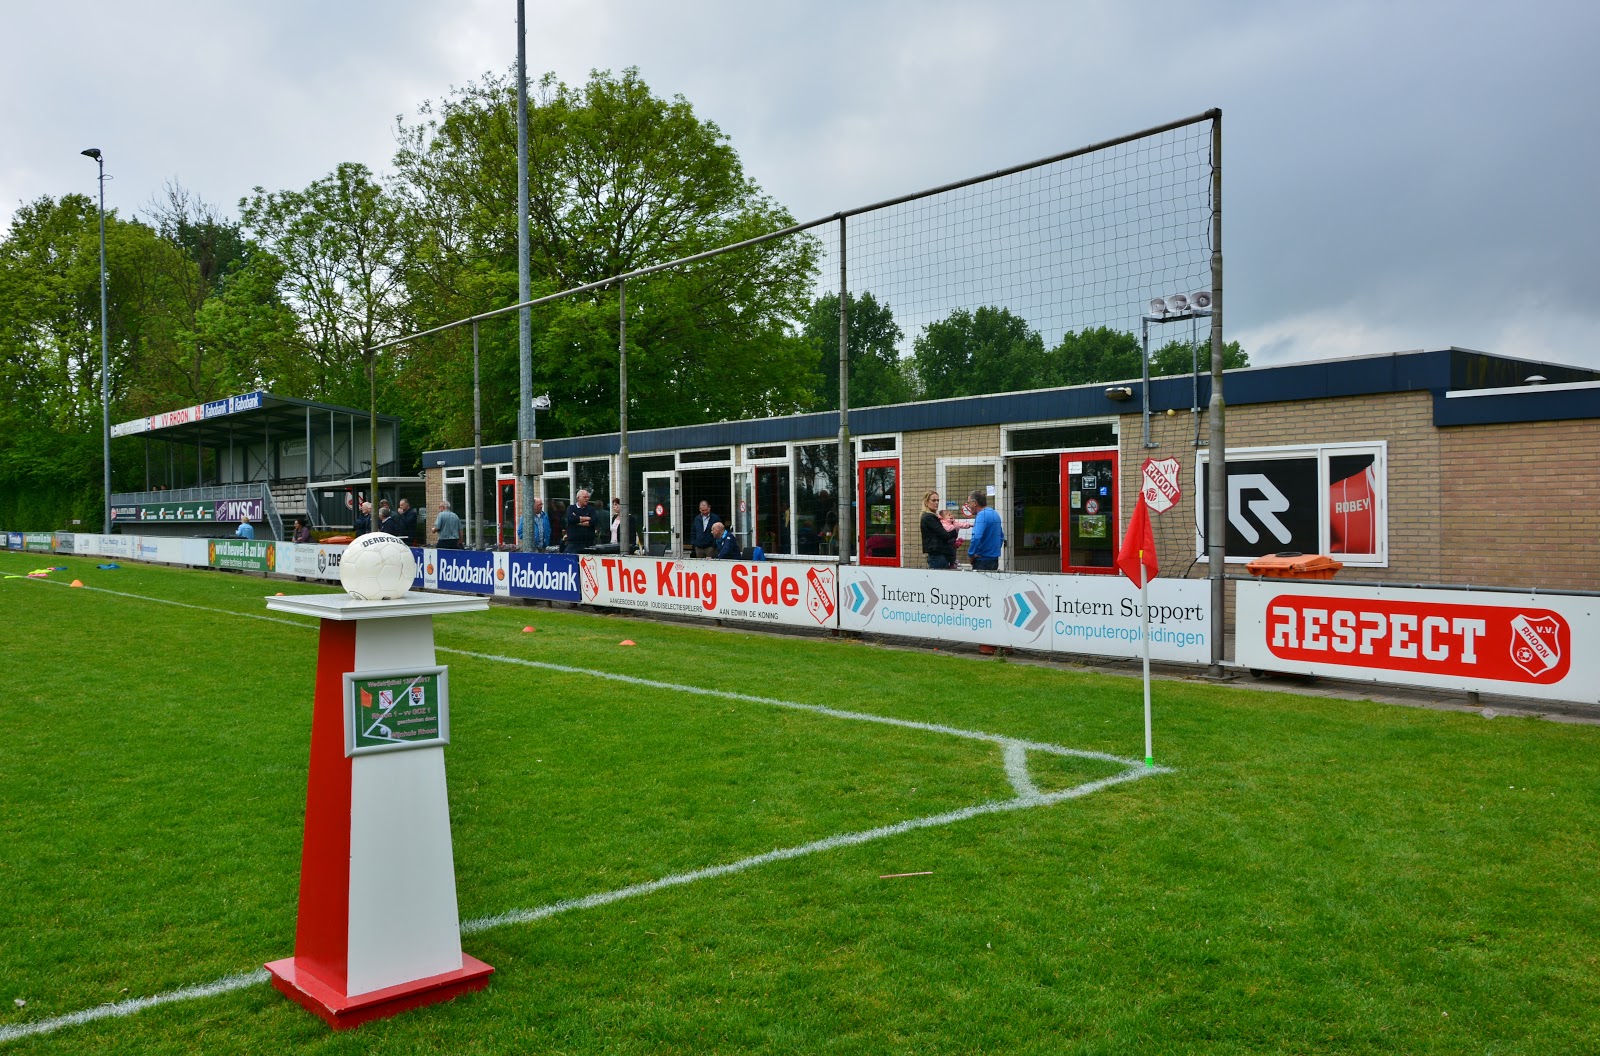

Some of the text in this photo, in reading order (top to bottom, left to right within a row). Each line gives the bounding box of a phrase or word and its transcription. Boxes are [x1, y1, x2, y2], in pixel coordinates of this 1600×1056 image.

[205, 401, 227, 418] Rabobank
[235, 392, 259, 411] Rabobank
[169, 410, 189, 425] RHOON
[1145, 463, 1177, 499] RHOON
[228, 500, 263, 520] MYSC.nl
[1335, 498, 1370, 514] ROBEY
[440, 558, 493, 586] Rabobank
[511, 562, 578, 592] Rabobank
[601, 558, 800, 611] The King Side
[812, 577, 830, 607] RHOON
[881, 584, 992, 611] Intern Support
[609, 598, 636, 606] AANGEBODEN
[719, 608, 730, 616] AAN
[731, 608, 748, 618] EDWIN
[758, 611, 779, 620] KONING
[881, 607, 992, 631] Computeropleidingen
[1055, 595, 1204, 625] Intern Support
[1272, 605, 1486, 665] RESPECT
[1521, 626, 1550, 659] RHOON
[1536, 626, 1555, 634] V.V.
